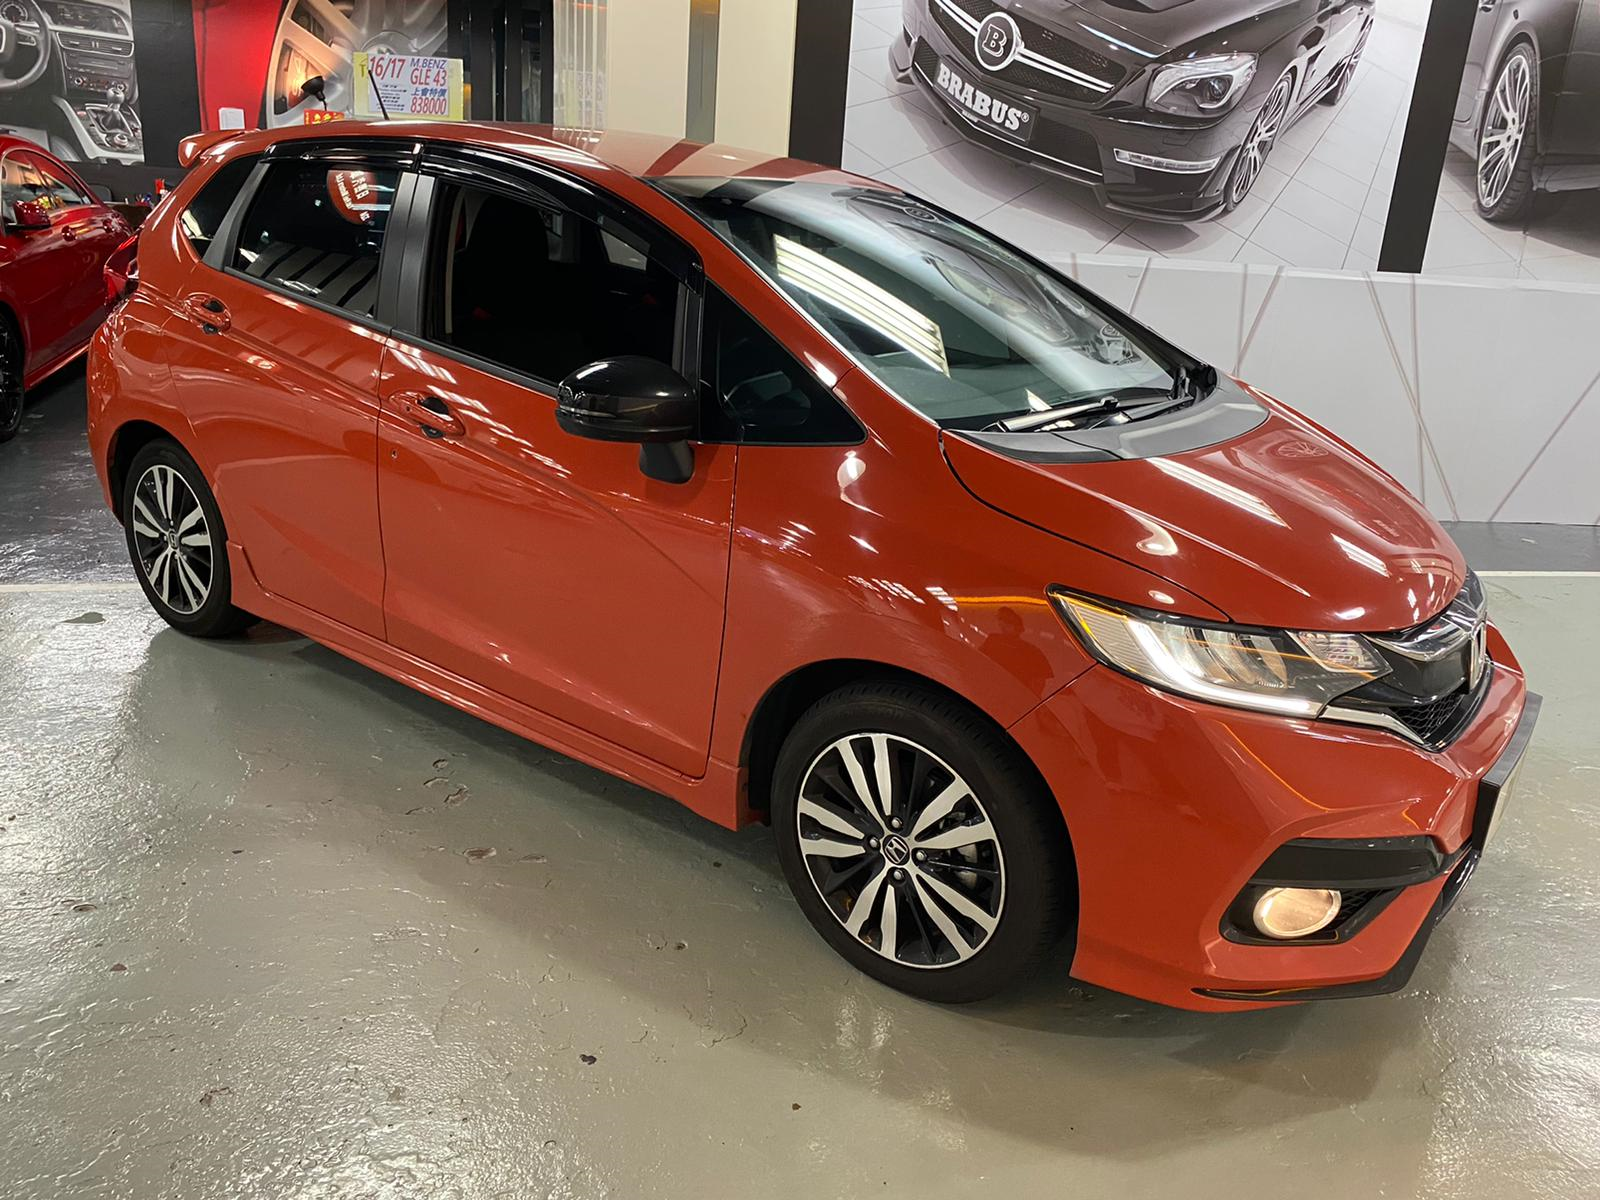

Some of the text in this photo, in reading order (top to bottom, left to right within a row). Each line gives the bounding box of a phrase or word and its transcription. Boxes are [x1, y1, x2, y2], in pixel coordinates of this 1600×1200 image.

[370, 56, 405, 80] 16/17
[410, 58, 447, 70] M.BENZ
[410, 68, 447, 87] GLE 43
[411, 87, 448, 98] 上會特價
[410, 97, 447, 115] 838000
